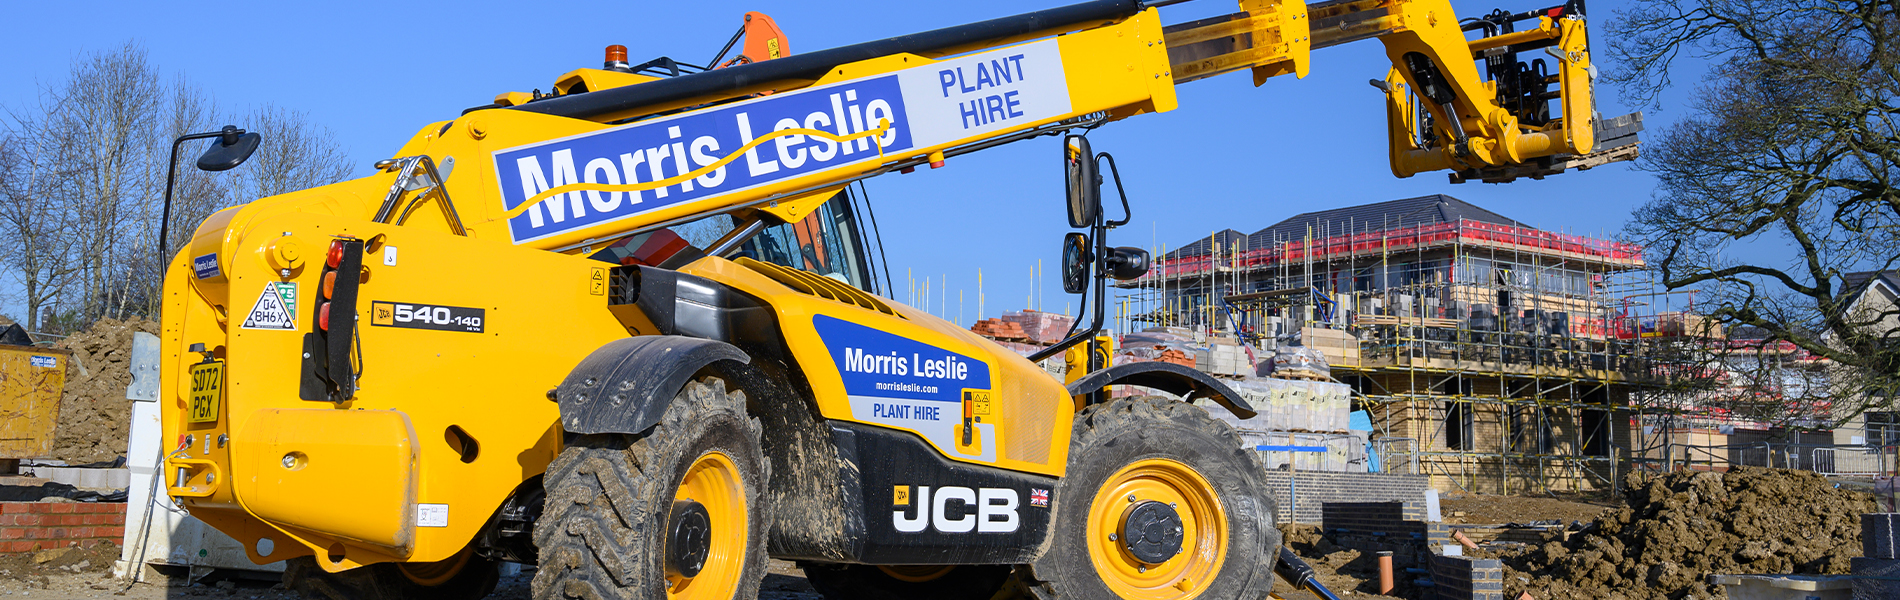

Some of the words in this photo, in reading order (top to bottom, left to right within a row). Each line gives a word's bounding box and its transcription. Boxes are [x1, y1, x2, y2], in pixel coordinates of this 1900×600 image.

[939, 54, 1024, 98] PLANT
[959, 90, 1024, 129] HIRE
[516, 126, 727, 229] Morris
[736, 89, 897, 178] Leslie
[255, 311, 284, 323] BH6X
[263, 299, 276, 310] 04
[845, 347, 908, 376] Morris
[913, 353, 968, 381] Leslie
[193, 367, 218, 392] SD72
[875, 382, 938, 394] morrisleslie.com
[193, 395, 213, 418] PGX
[873, 403, 911, 420] PLANT
[914, 406, 940, 421] HIRE
[893, 486, 1019, 532] JCB
